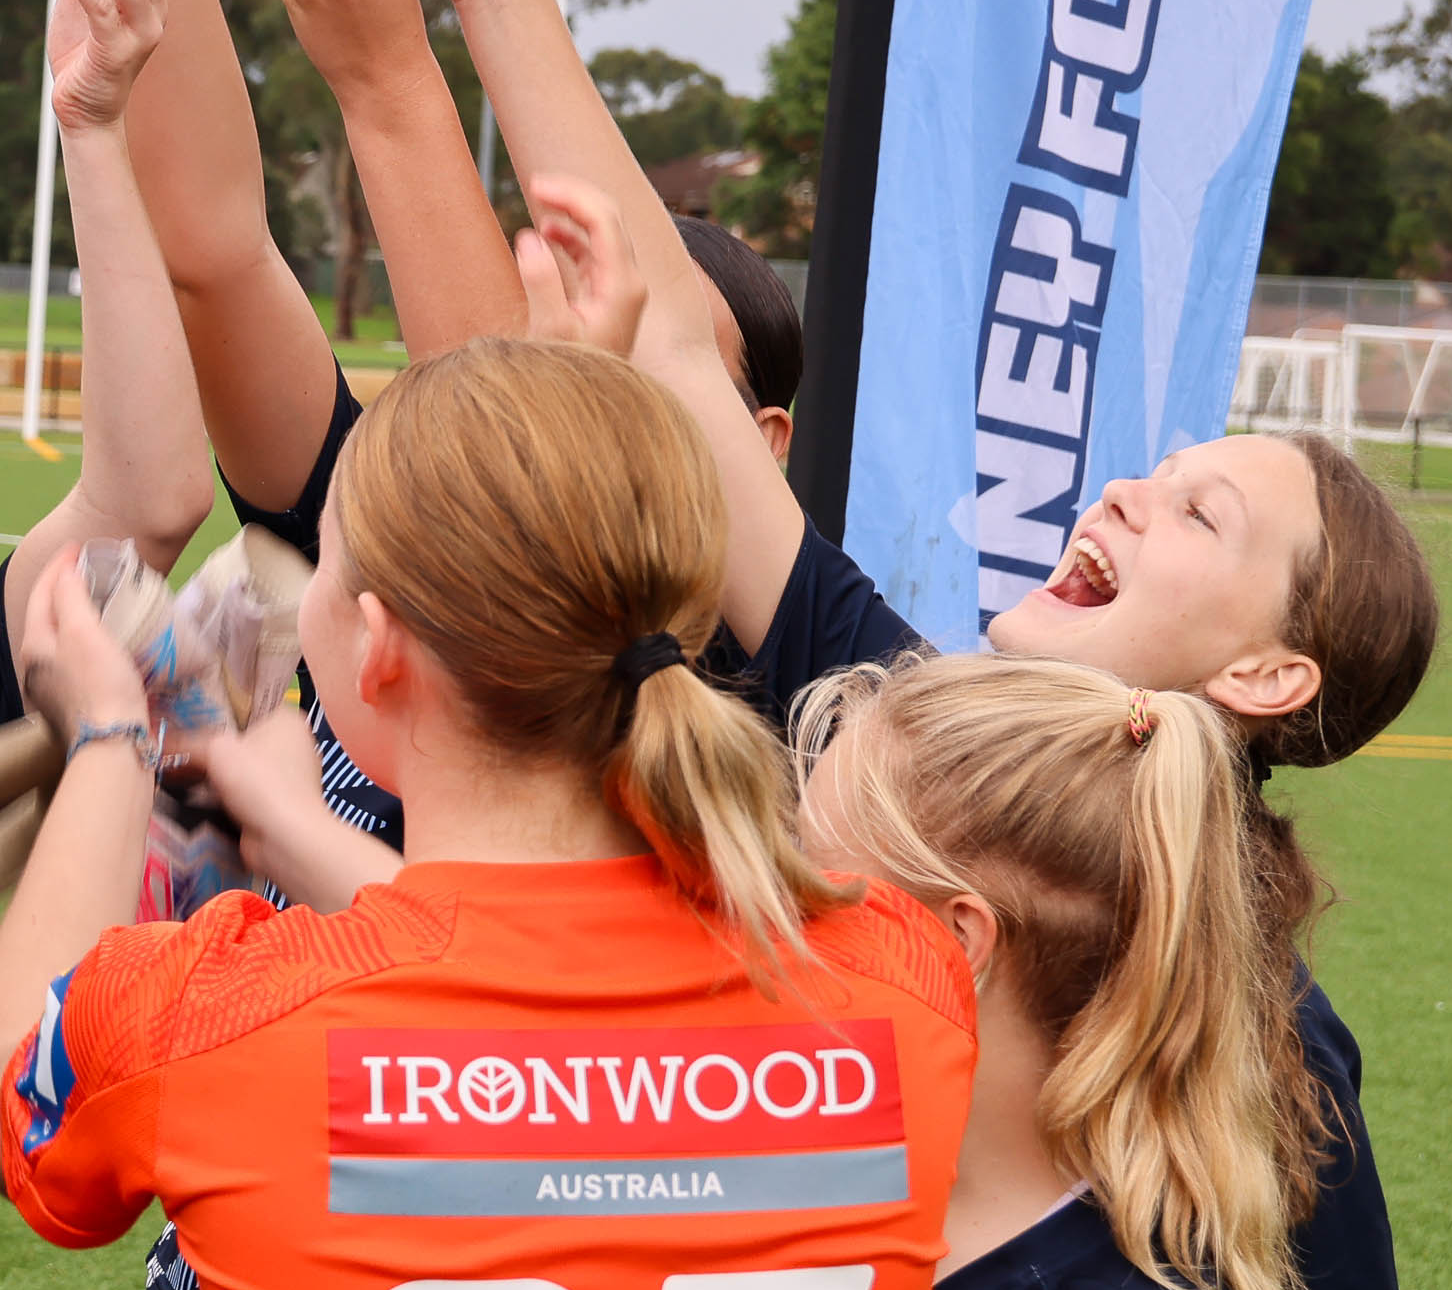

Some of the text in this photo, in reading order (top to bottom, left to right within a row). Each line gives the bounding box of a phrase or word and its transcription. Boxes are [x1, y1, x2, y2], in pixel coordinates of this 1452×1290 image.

[975, 187, 1111, 589] NEY
[361, 1048, 876, 1126] IRONWOOD
[535, 1170, 724, 1202] AUSTRALIA
